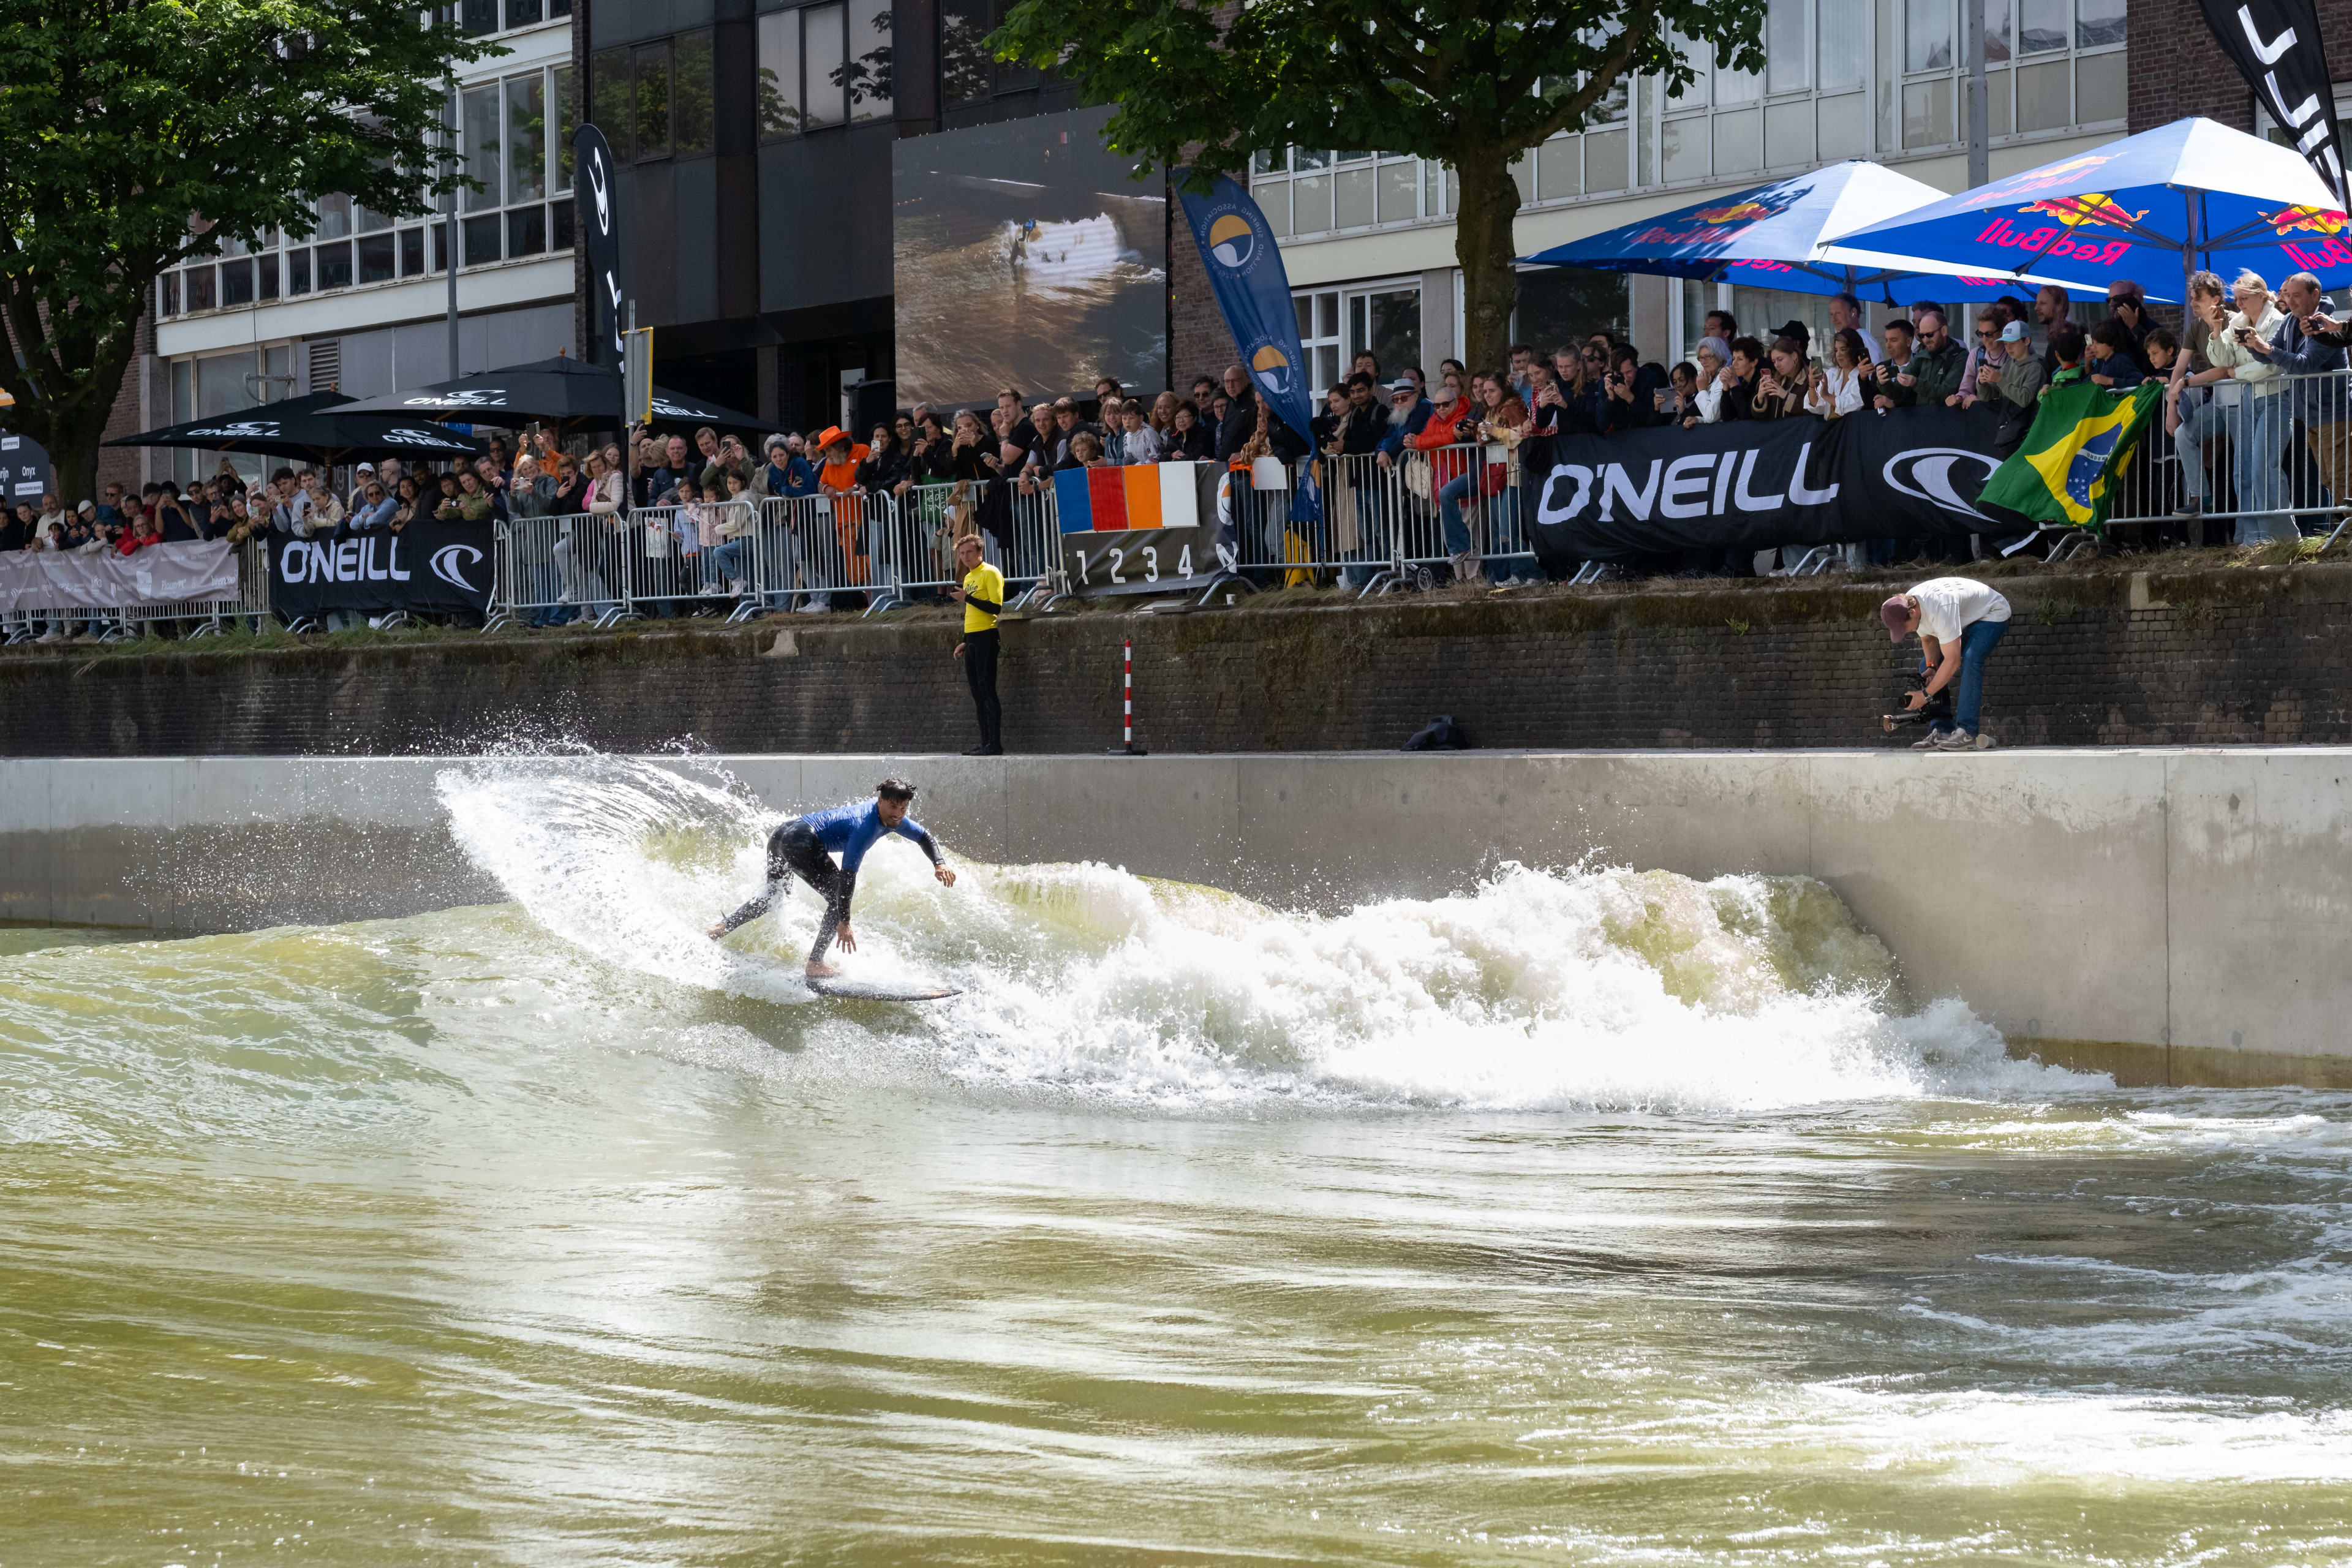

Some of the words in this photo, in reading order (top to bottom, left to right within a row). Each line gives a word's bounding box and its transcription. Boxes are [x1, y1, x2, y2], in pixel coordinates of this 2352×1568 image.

[22, 466, 36, 480] Onyx
[1538, 442, 1839, 524] O'NEILL
[280, 537, 410, 583] O'NEILL
[1077, 551, 1088, 584] 1
[1109, 548, 1126, 583] 2
[1142, 546, 1159, 582] 3
[1178, 544, 1193, 580] 4
